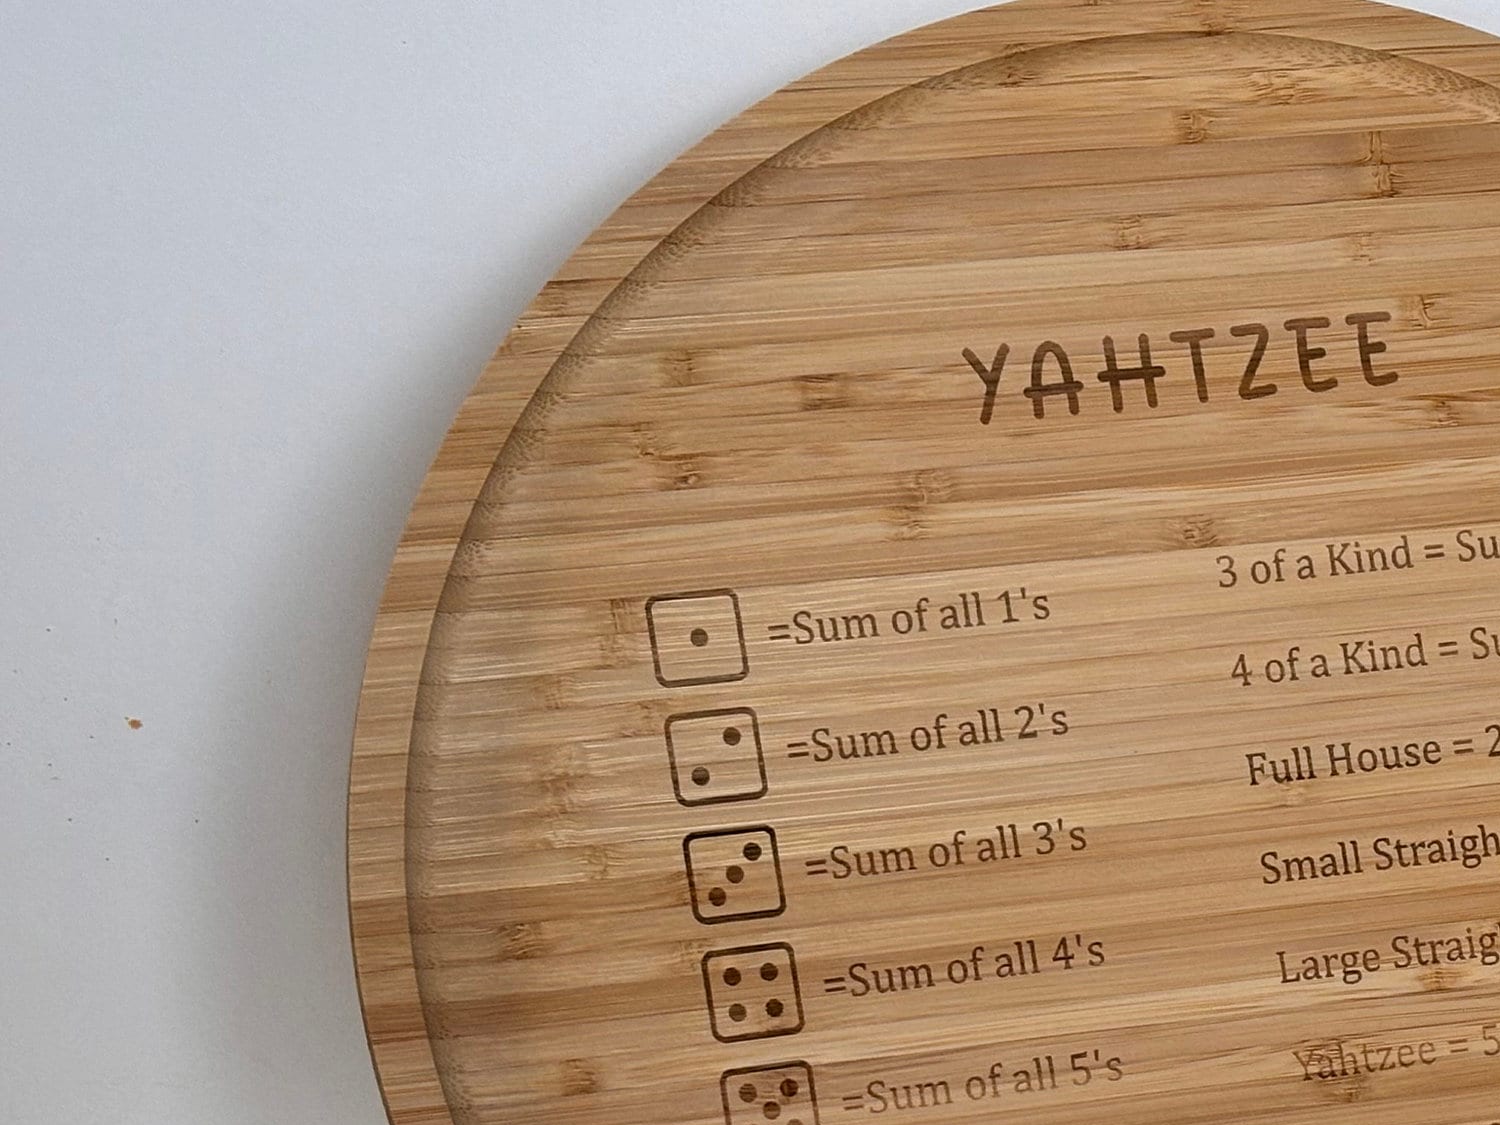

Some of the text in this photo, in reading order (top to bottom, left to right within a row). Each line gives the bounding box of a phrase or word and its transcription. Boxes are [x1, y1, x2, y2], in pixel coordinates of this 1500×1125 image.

[962, 311, 1399, 425] YAHTZEE
[1216, 555, 1238, 588] 3
[1250, 549, 1288, 585] of
[1297, 555, 1316, 579] a
[1327, 535, 1415, 578] Kind
[1424, 543, 1446, 561] =
[767, 588, 1051, 645] =Sum of all 1's
[1231, 653, 1253, 687] 4
[1265, 647, 1302, 683] of
[1310, 653, 1329, 677] a
[1340, 634, 1429, 675] Kind
[1439, 640, 1459, 658] =
[787, 703, 1069, 763] =Sum of all 2's
[1245, 747, 1315, 786] Full
[1328, 736, 1442, 777] House
[1453, 738, 1474, 756] =
[805, 819, 1088, 880] =Sum of all 3's
[1261, 841, 1364, 885] Small
[823, 934, 1106, 997] =Sum of all 4's
[1276, 937, 1382, 987] Large
[842, 1050, 1123, 1115] =Sum of all 5's
[1293, 1036, 1438, 1081] Yahtzee
[1450, 1037, 1469, 1055] =
